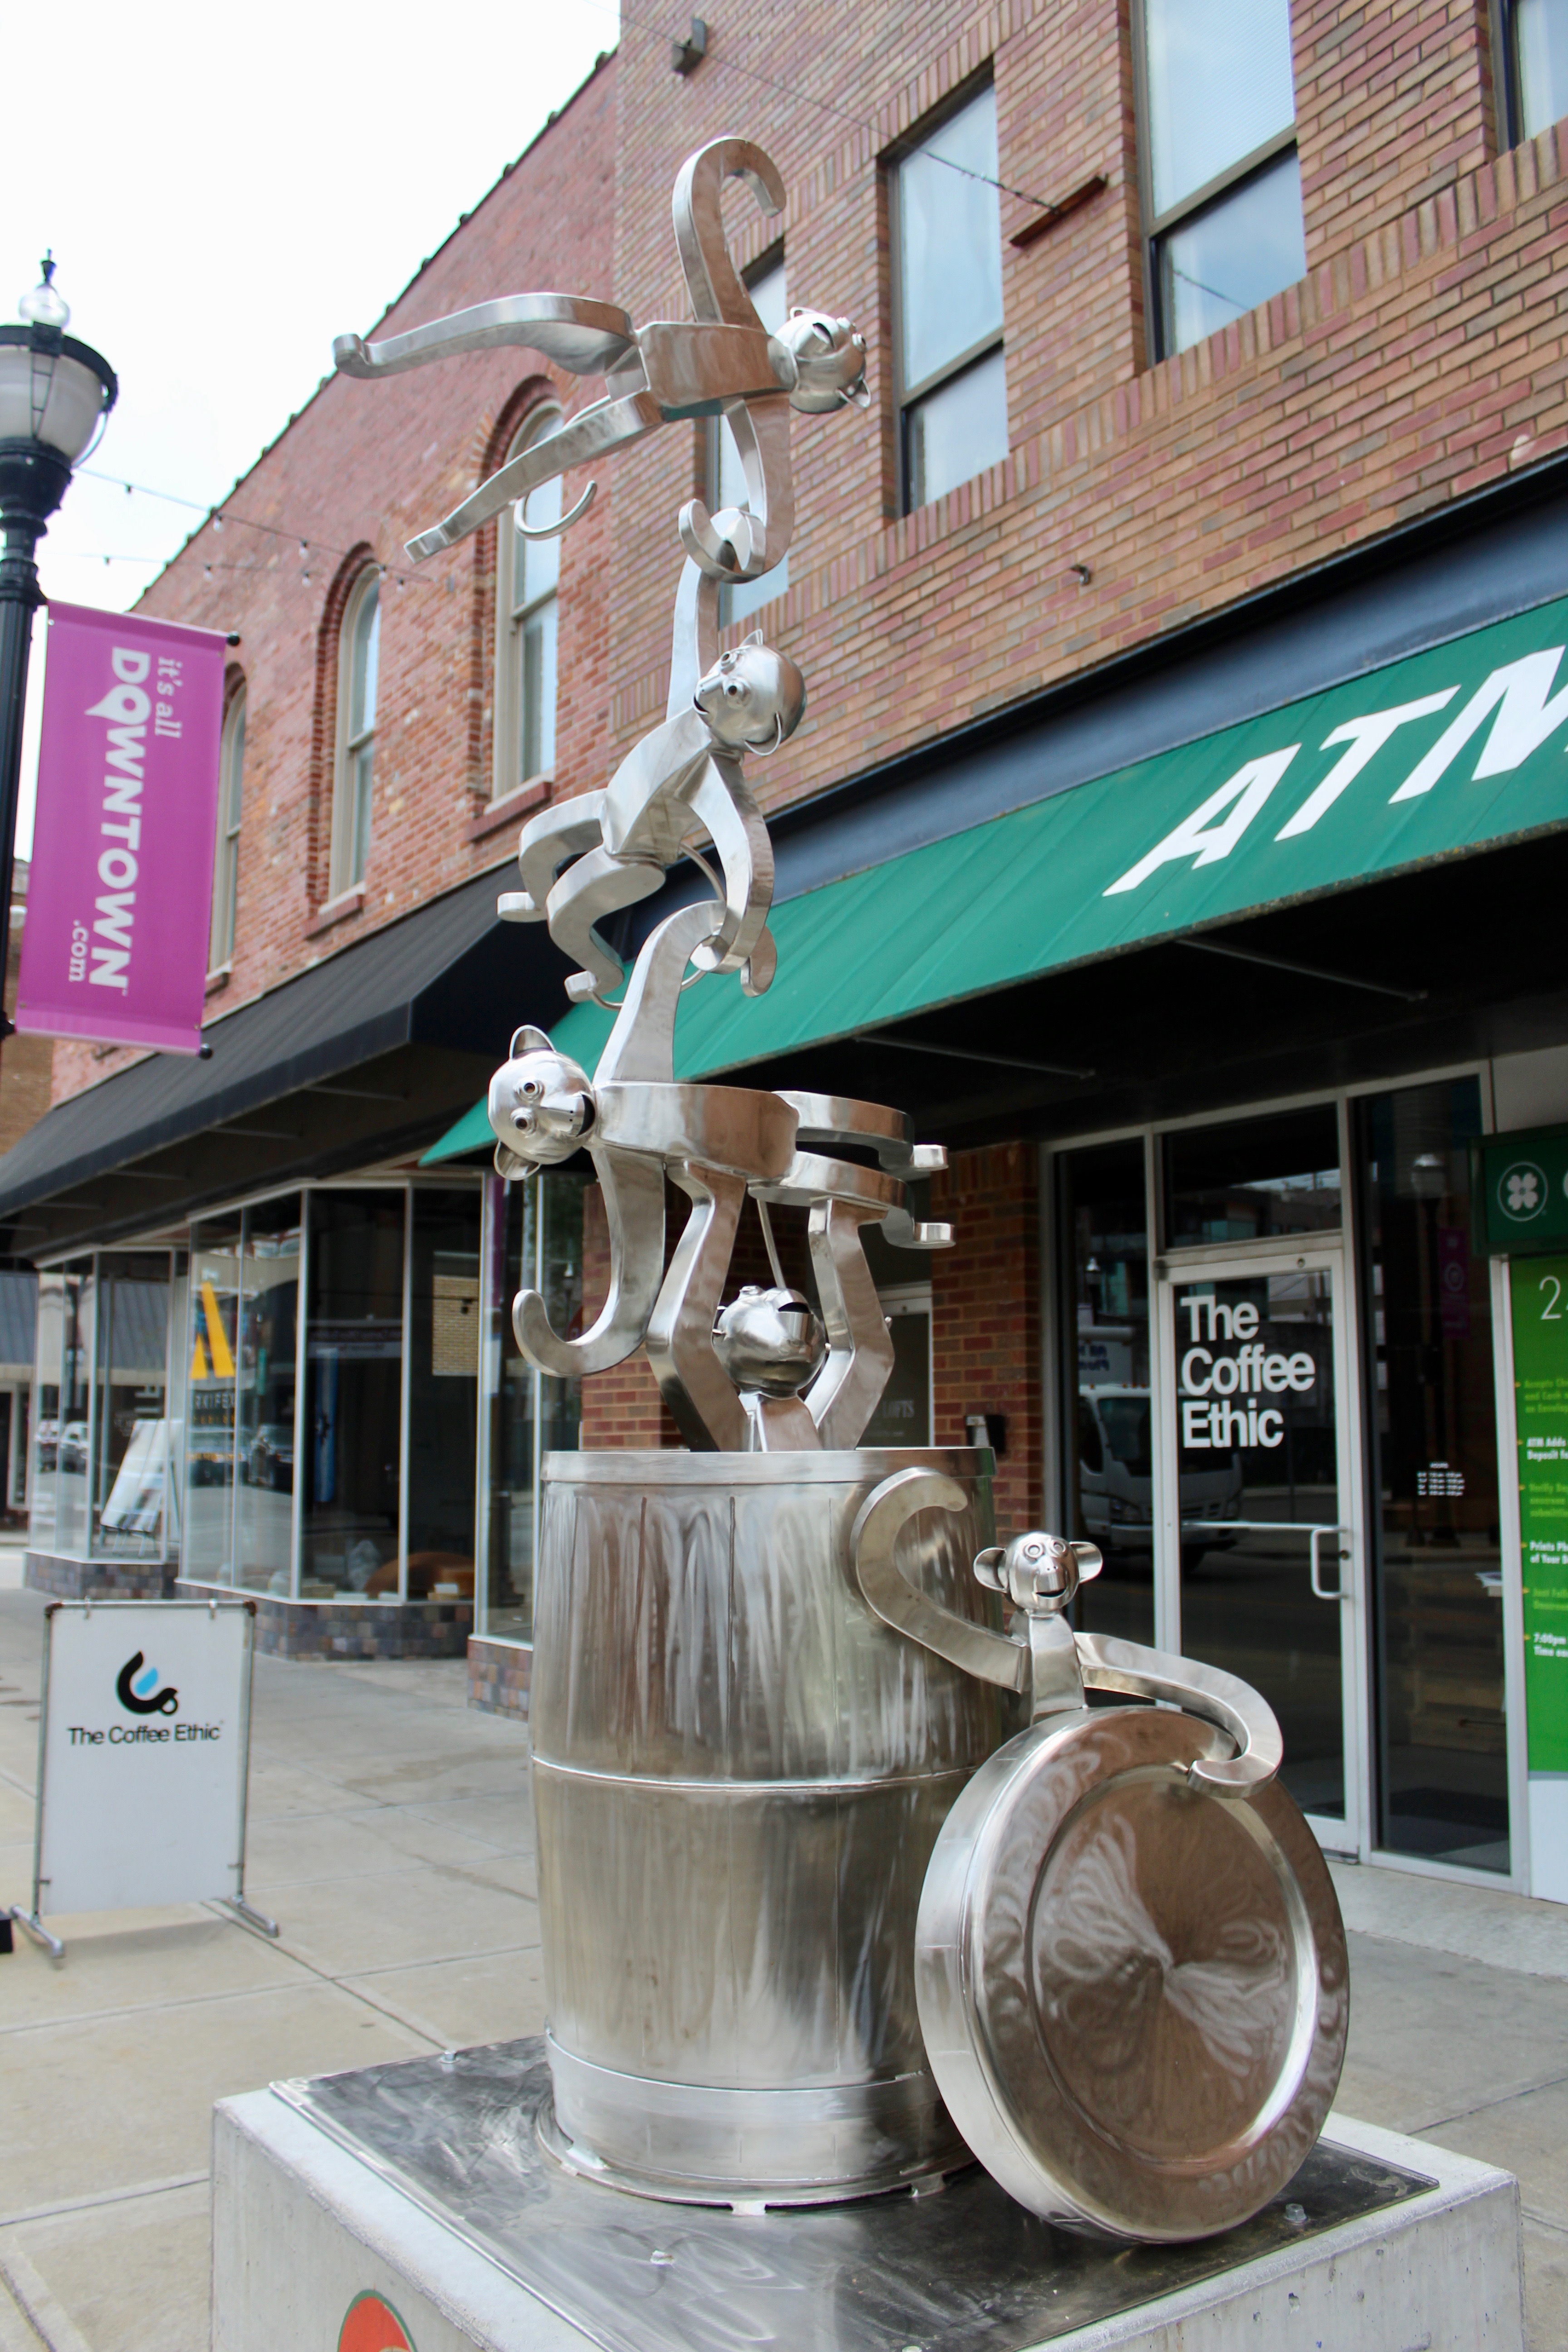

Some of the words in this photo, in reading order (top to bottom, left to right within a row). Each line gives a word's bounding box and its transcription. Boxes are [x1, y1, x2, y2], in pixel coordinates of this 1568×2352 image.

[157, 657, 183, 696] it's
[155, 701, 181, 739] all
[1102, 644, 1568, 897] ATM
[84, 646, 152, 989] DOWNTOWN
[69, 919, 89, 982] .com
[1180, 1295, 1260, 1343] The
[1539, 1275, 1568, 1320] 2
[1181, 1343, 1316, 1396] Coffee
[1182, 1397, 1284, 1448] Ethic
[68, 1727, 105, 1745] The
[108, 1724, 171, 1744] Coffee
[174, 1724, 220, 1741] Ethic
